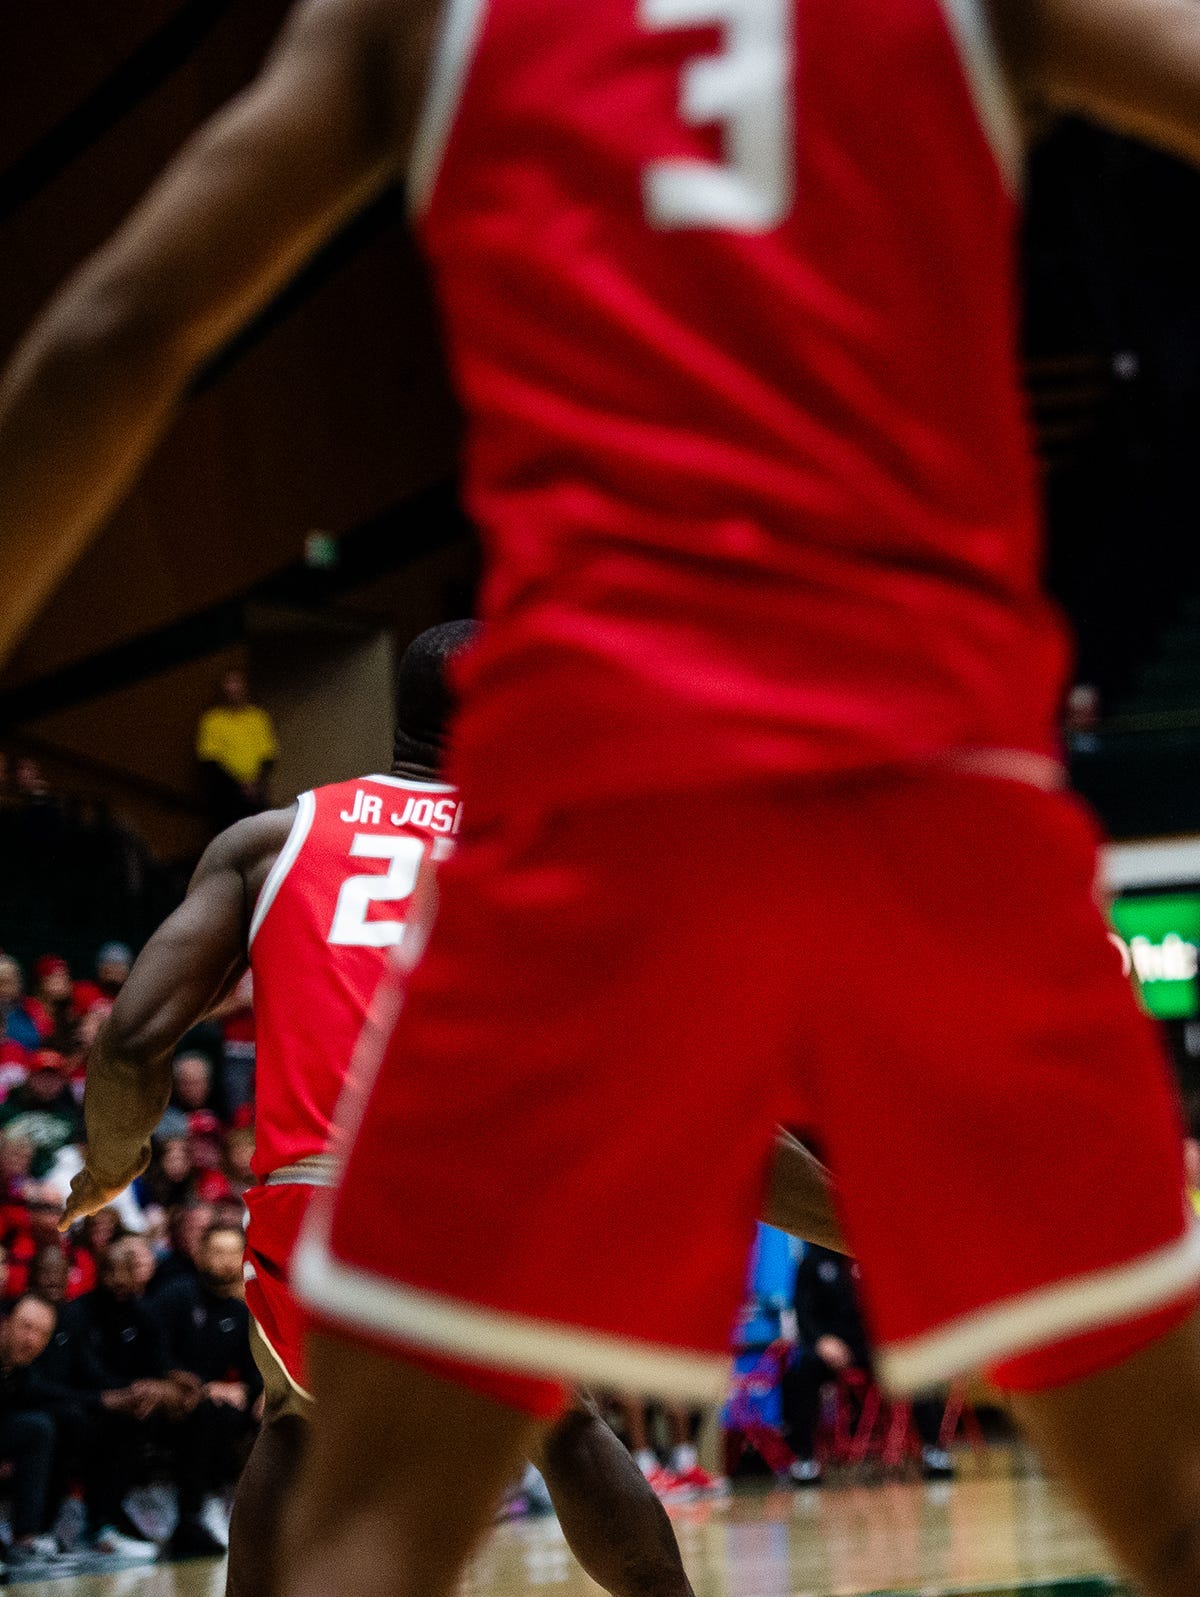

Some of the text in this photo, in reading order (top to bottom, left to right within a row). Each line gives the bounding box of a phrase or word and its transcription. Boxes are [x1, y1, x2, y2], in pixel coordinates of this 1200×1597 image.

[638, 0, 796, 234] 3
[340, 789, 383, 824] JR
[327, 833, 457, 947] 2
